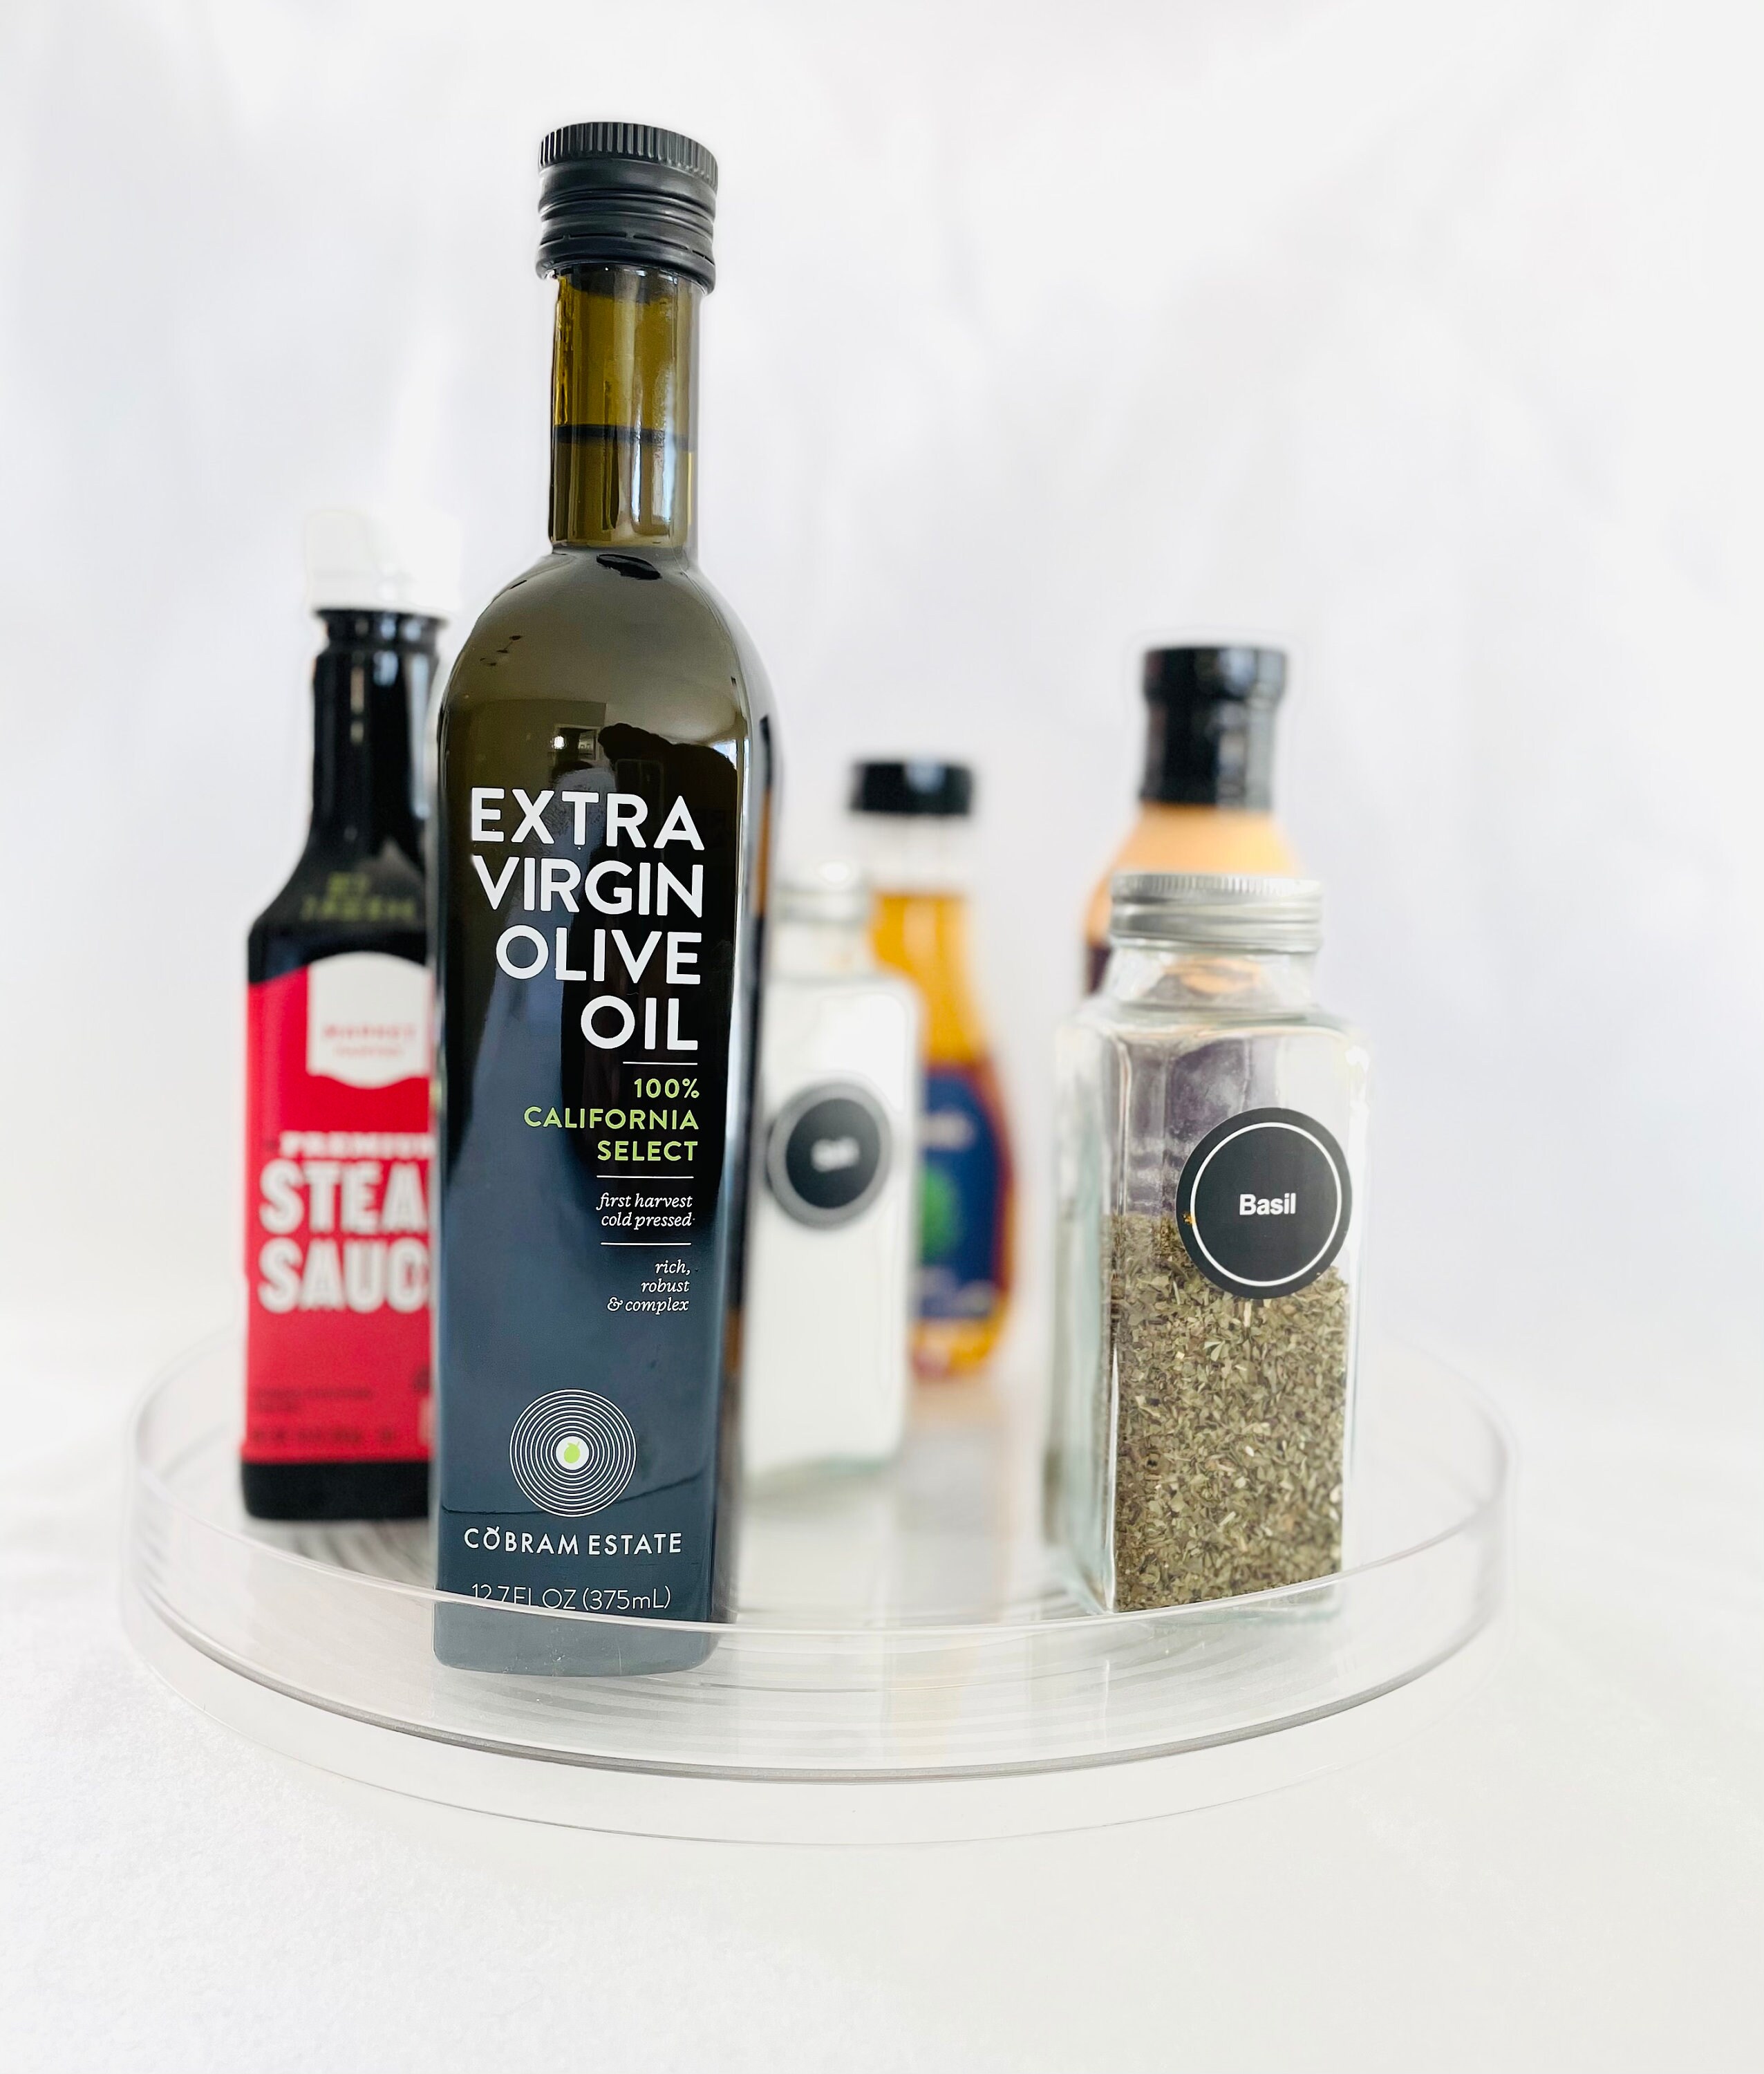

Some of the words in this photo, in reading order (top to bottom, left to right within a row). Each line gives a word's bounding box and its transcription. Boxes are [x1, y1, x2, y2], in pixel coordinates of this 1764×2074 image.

[471, 787, 705, 850] EXTRA
[472, 855, 704, 918] VIRGIN
[496, 925, 702, 984] OLIVE
[581, 996, 698, 1051] OIL
[634, 1078, 700, 1099] 100%
[524, 1106, 699, 1130] CALIFORNIA
[597, 1140, 698, 1161] SELECT
[259, 1158, 430, 1235] STEA
[596, 1192, 632, 1211] first
[635, 1193, 693, 1208] harvest
[1239, 1193, 1297, 1215] Basil
[601, 1212, 632, 1226] cold
[634, 1212, 693, 1231] pressed
[257, 1237, 430, 1314] SAUC
[655, 1259, 691, 1276] rich,
[641, 1278, 691, 1293] robust
[607, 1296, 623, 1311] &
[625, 1296, 689, 1315] complex
[588, 1533, 682, 1556] ESTATE
[542, 1589, 576, 1609] OZ
[583, 1585, 670, 1610] (375mL)
